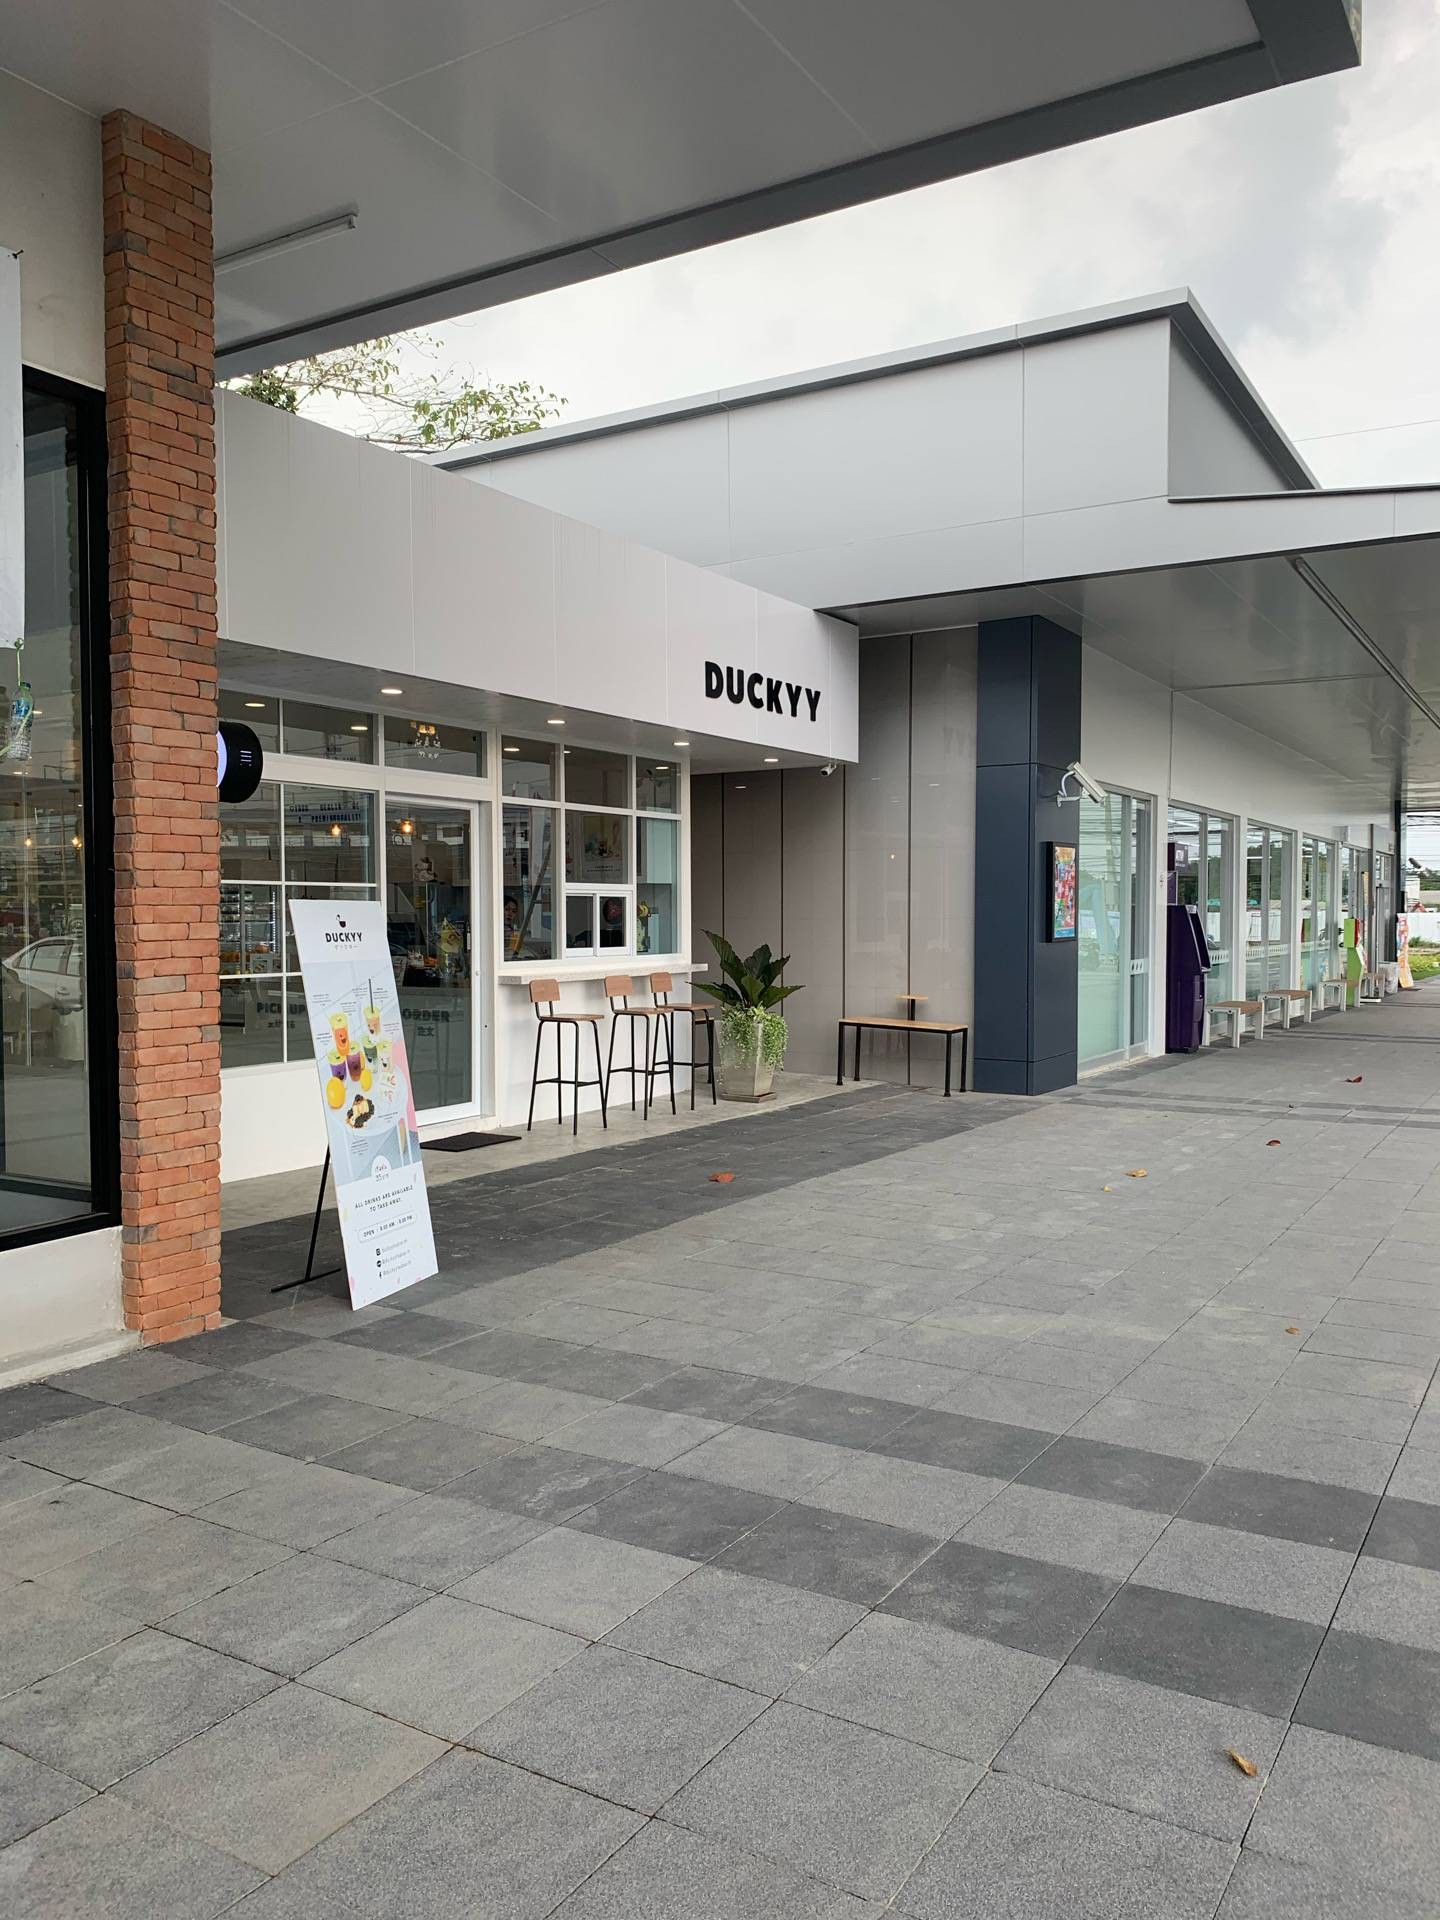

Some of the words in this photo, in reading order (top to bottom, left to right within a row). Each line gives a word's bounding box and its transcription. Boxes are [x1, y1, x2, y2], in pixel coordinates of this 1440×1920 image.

[705, 661, 821, 722] DUCKYY
[325, 932, 362, 943] DUCKYY
[402, 1008, 450, 1023] ORDER
[364, 1195, 381, 1207] DRINKS
[382, 1192, 391, 1200] ARE
[392, 1185, 414, 1196] AVAILABLE
[377, 1202, 389, 1210] TAKE
[363, 1229, 375, 1238] OPEN
